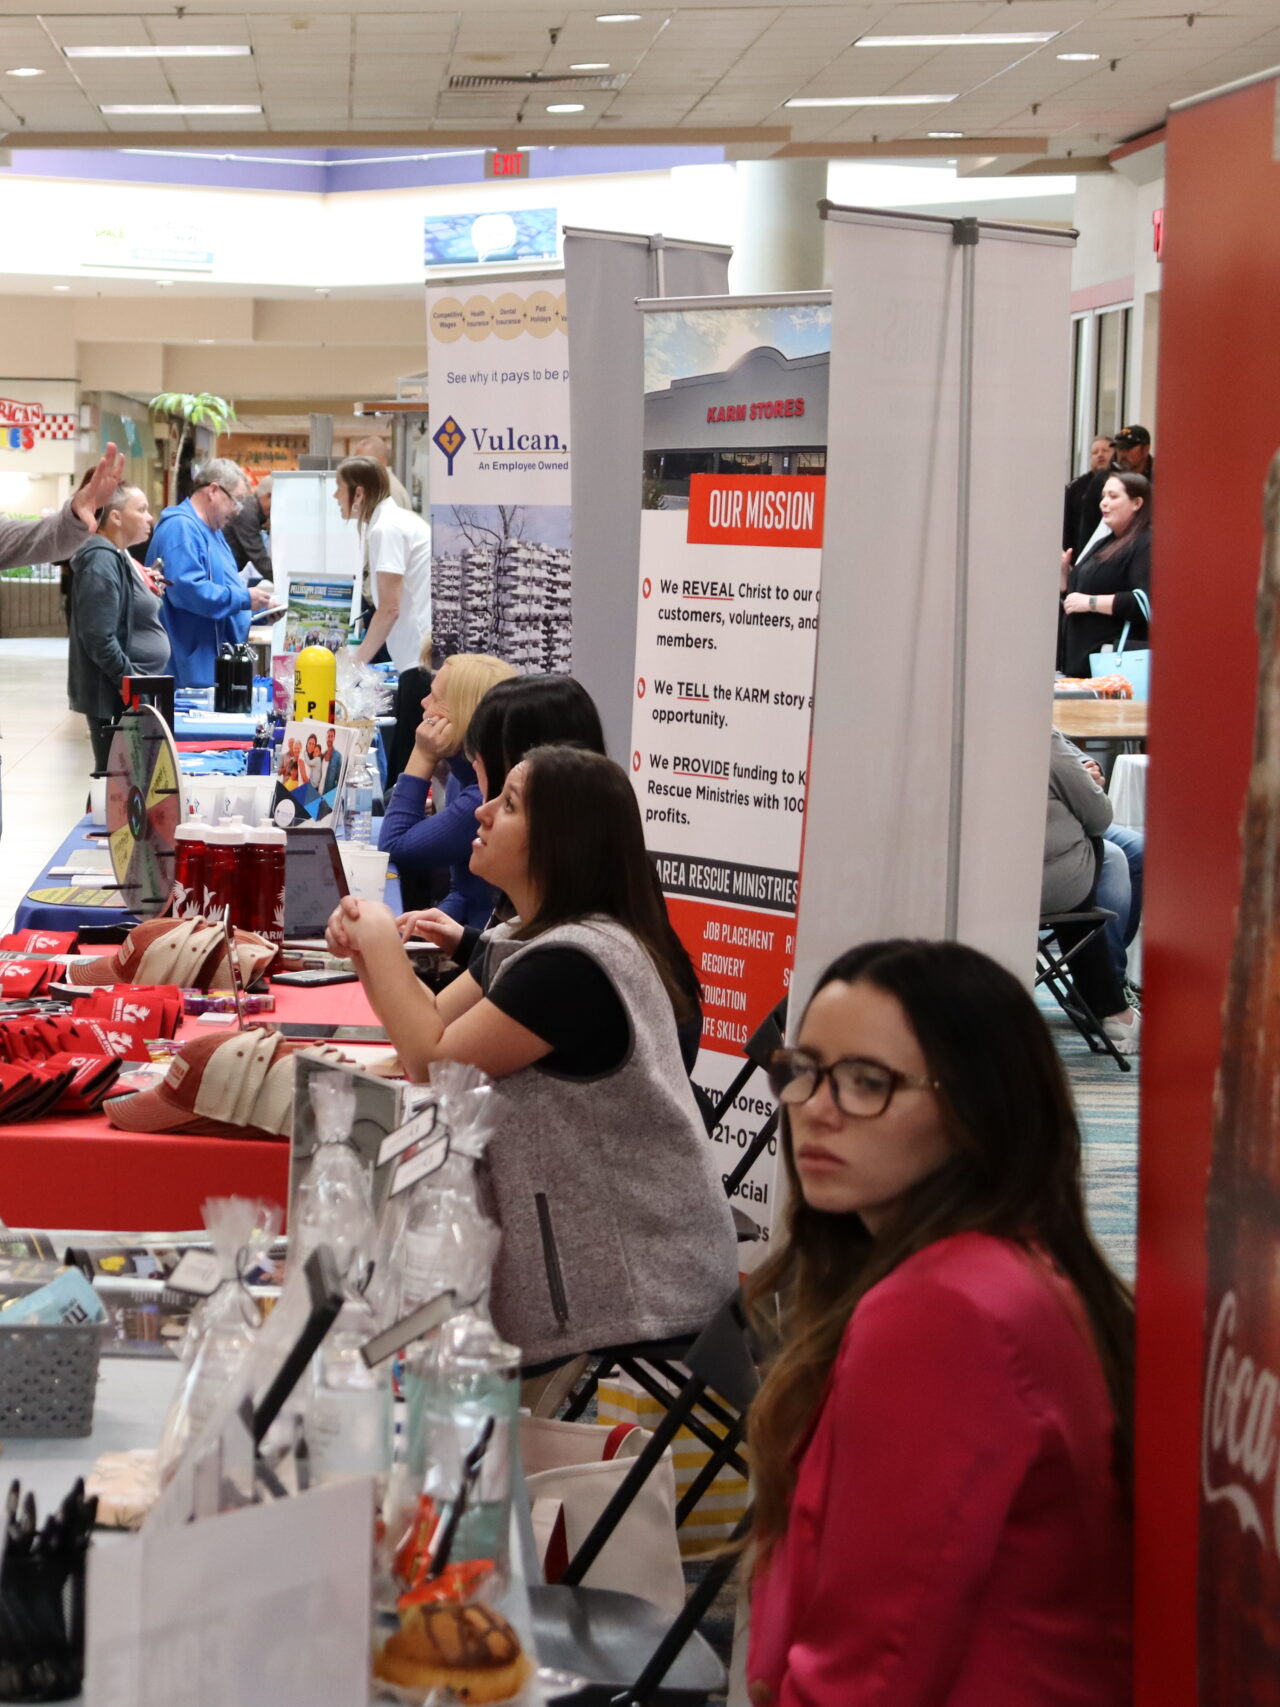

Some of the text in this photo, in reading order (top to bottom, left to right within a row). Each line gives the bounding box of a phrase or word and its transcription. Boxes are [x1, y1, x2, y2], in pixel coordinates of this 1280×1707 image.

[493, 153, 523, 176] EXIT
[447, 371, 467, 384] See
[470, 372, 489, 385] why
[491, 370, 498, 382] it
[501, 371, 530, 384] pays
[532, 370, 542, 380] to
[544, 368, 559, 380] be
[707, 397, 805, 423] KARM STORES
[471, 427, 568, 454] Vulcan,
[479, 461, 569, 472] An Employee Owned
[709, 489, 815, 530] OUR MISSION
[660, 579, 679, 595] We
[682, 581, 734, 598] REVEAL
[738, 583, 772, 600] Christ
[775, 587, 789, 601] to
[793, 590, 812, 602] our
[658, 608, 818, 631] customers, volunteers, and
[656, 633, 717, 650] members.
[654, 680, 673, 695] We
[677, 682, 709, 700] TELL
[713, 685, 732, 701] the
[735, 687, 770, 705] KARM
[773, 691, 805, 709] story
[652, 708, 728, 729] opportunity.
[649, 754, 669, 770] We
[673, 756, 730, 777] PROVIDE
[733, 763, 778, 785] funding
[781, 769, 795, 784] to
[647, 780, 692, 798] Rescue
[696, 785, 750, 807] Ministries
[753, 791, 780, 811] with
[645, 807, 691, 826] profits.
[655, 859, 799, 905] AREA RESCUE MINISTRIES
[703, 920, 720, 941] JOB
[721, 924, 775, 951] PLACEMENT
[701, 952, 745, 979] RECOVERY
[703, 1016, 748, 1044] IFE SKILLS
